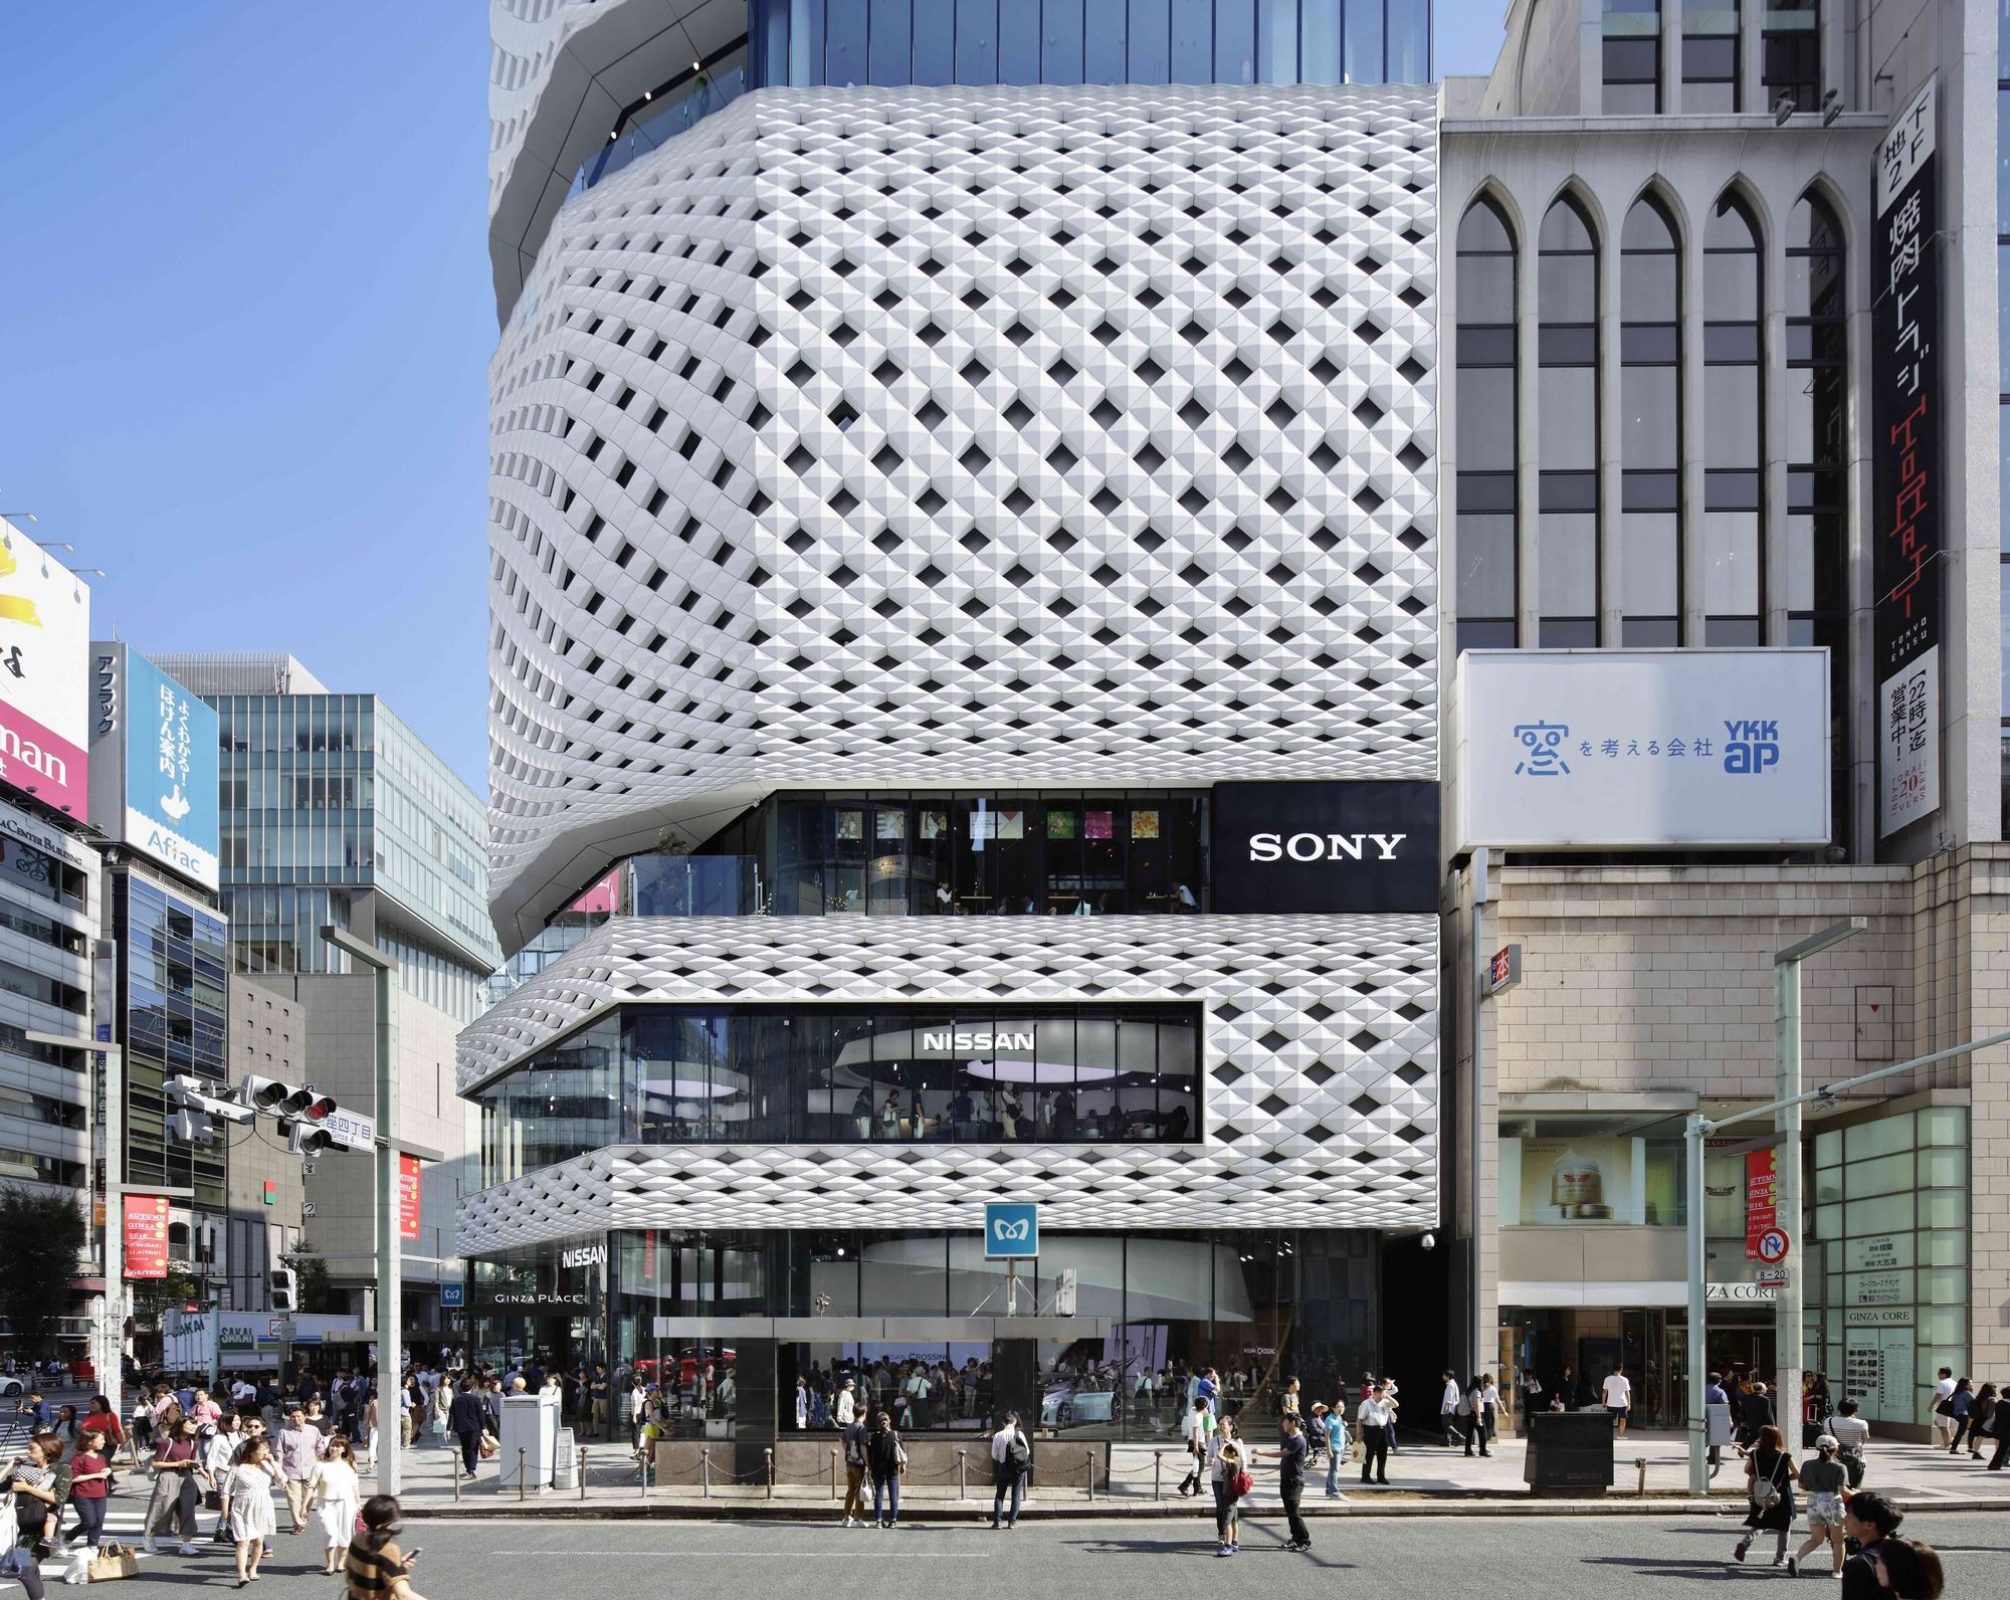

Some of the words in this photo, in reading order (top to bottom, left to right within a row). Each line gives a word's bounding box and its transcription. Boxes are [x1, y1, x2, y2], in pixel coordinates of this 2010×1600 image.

[1884, 92, 1930, 169] 地下
[1889, 128, 1924, 193] 2F
[1890, 189, 1929, 397] 焼肉トラジ
[98, 656, 115, 734] アフラック
[160, 683, 175, 780] ほけん案内
[1724, 720, 1778, 741] YKK
[7, 820, 44, 846] CENTER
[147, 829, 201, 874] Aflac
[1250, 833, 1407, 861] SONY
[923, 1033, 1034, 1051] NISSAN
[326, 1115, 371, 1140] 座四丁目
[562, 1245, 608, 1269] NISSAN
[495, 1293, 536, 1304] GINZA
[538, 1293, 580, 1304] PLACE
[1849, 1312, 1879, 1321] GINZA
[1882, 1311, 1910, 1321] CORE
[221, 1326, 253, 1344] SAKAI
